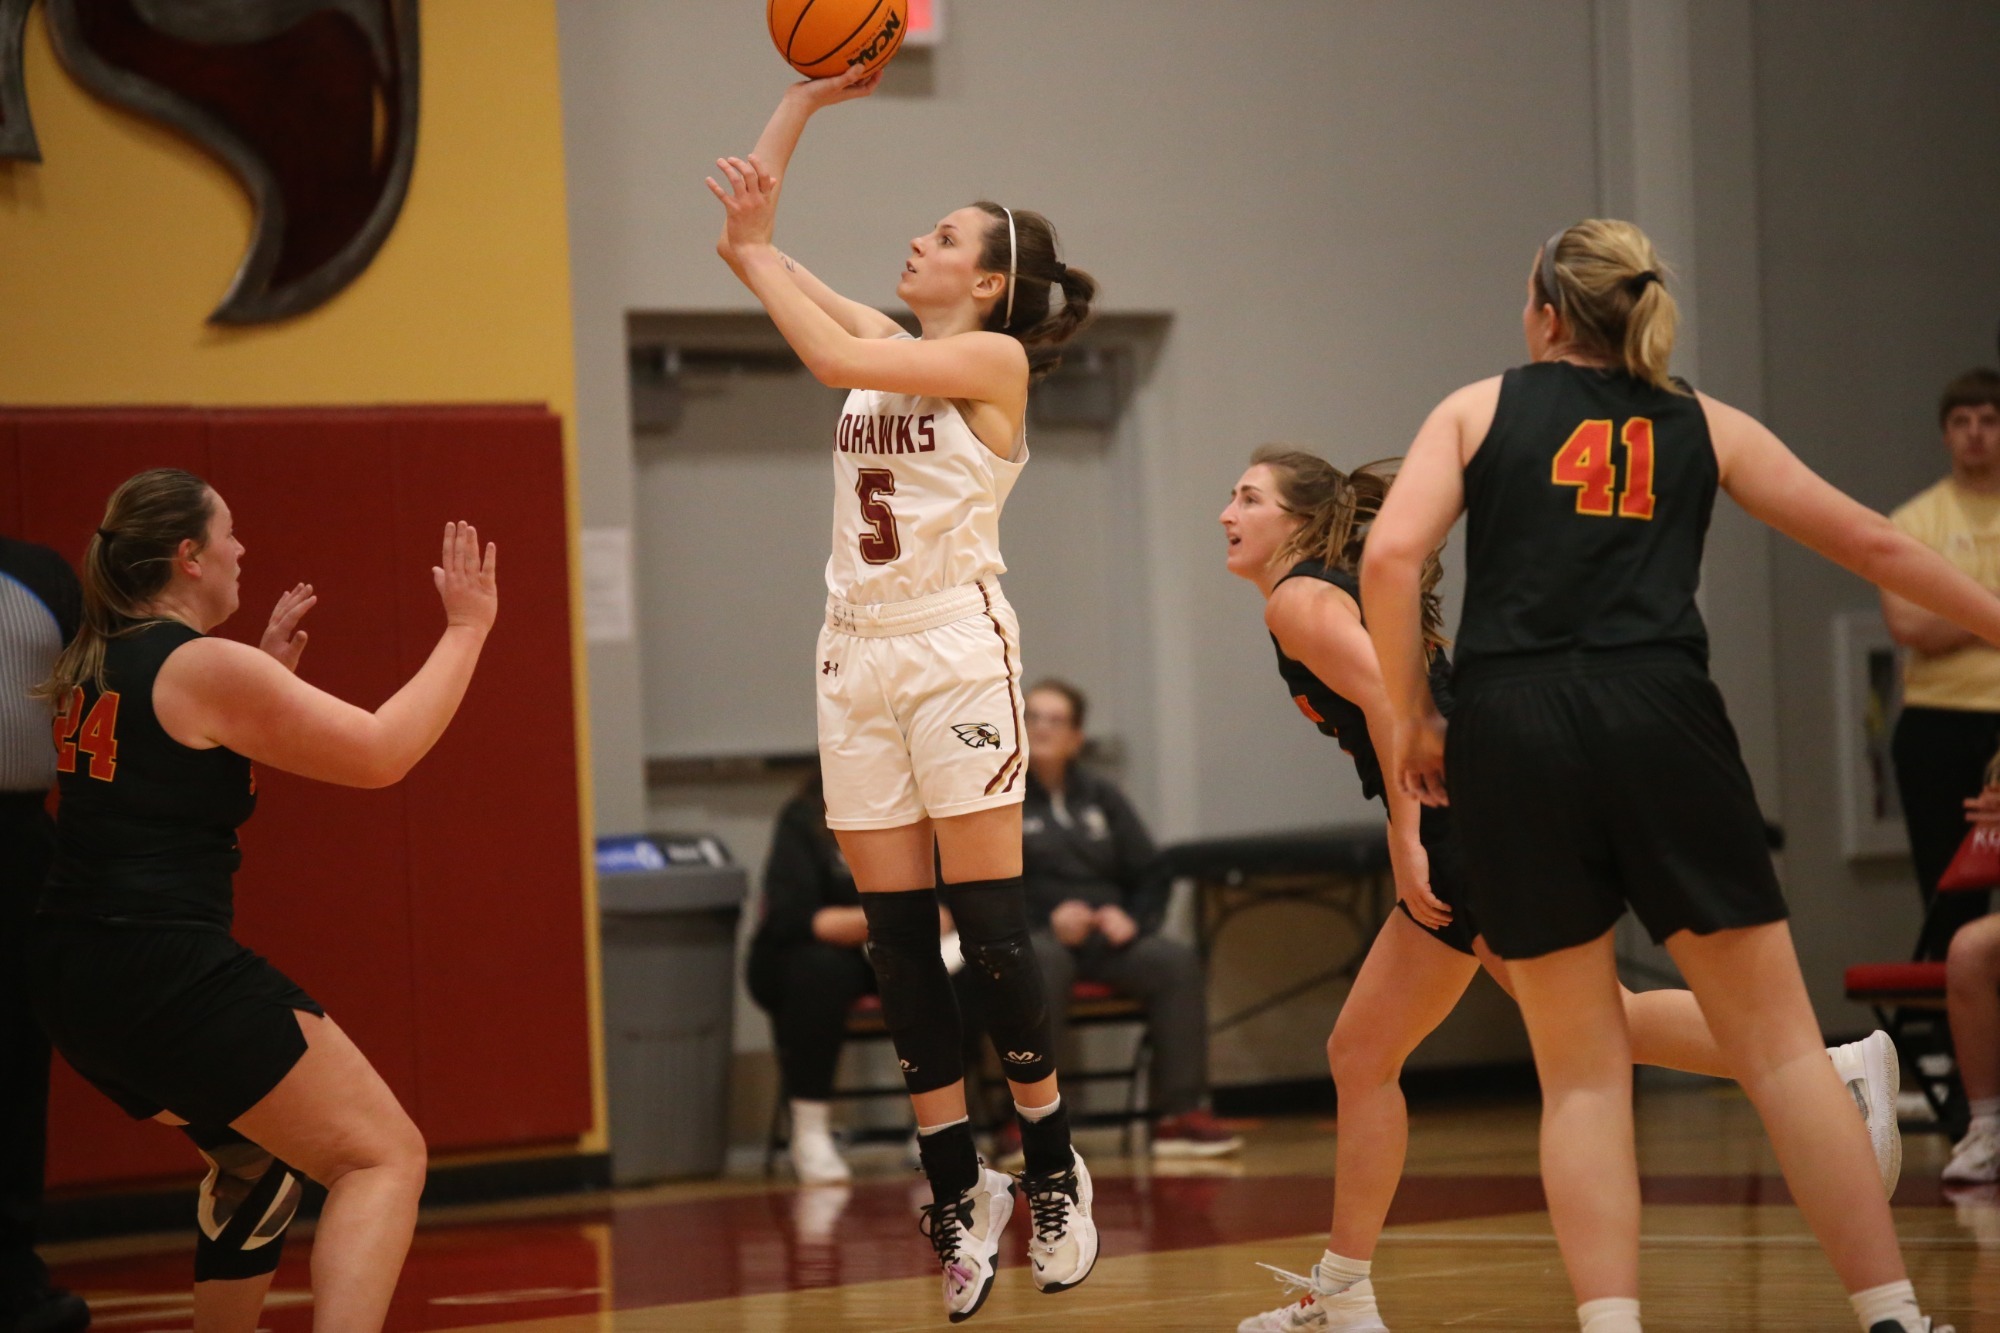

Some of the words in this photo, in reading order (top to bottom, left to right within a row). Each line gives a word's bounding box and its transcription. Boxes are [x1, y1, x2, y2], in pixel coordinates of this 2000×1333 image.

[834, 413, 935, 454] OHAWKS
[1551, 416, 1656, 521] 41
[855, 468, 901, 566] 5
[53, 686, 120, 783] 24
